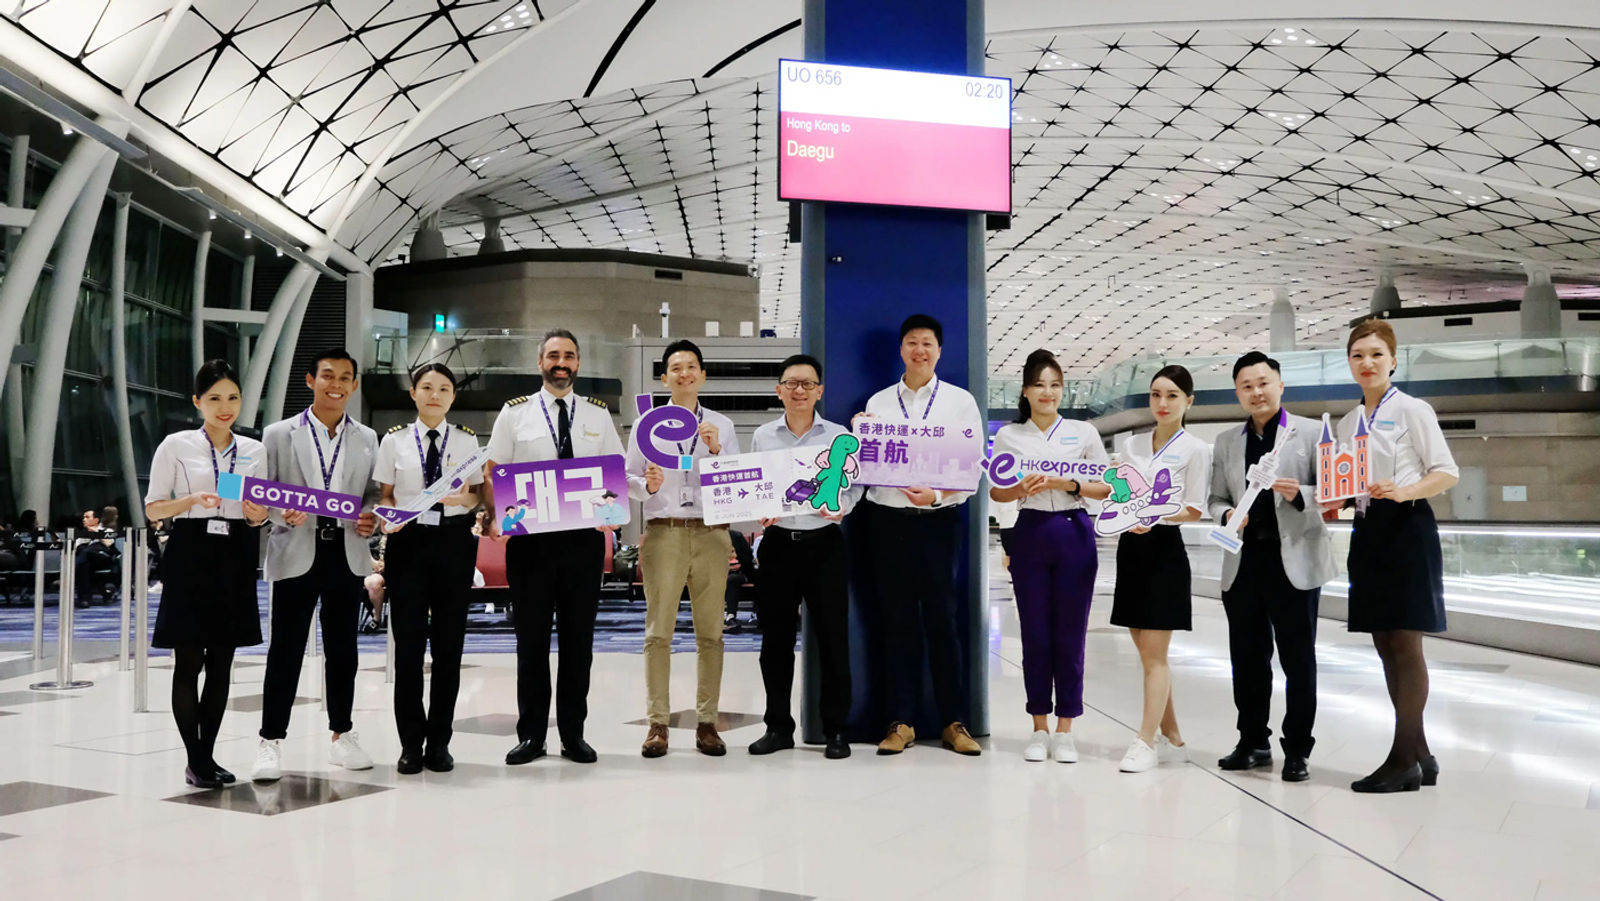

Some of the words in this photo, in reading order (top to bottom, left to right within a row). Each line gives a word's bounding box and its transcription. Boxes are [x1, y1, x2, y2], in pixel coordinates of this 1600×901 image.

[787, 67, 811, 83] UO
[815, 69, 842, 86] 656
[965, 81, 1003, 99] 02:20
[786, 117, 812, 133] Hong
[814, 119, 839, 134] Kong
[841, 122, 851, 133] to
[787, 140, 835, 163] Daegu
[860, 437, 909, 464] 首航
[712, 470, 759, 483] 香港快運首航
[1020, 459, 1107, 476] HKexpress
[514, 466, 607, 523] 대구
[713, 486, 731, 497] 香港
[754, 481, 774, 492] 大邱
[250, 484, 319, 509] GOTTA
[326, 498, 355, 514] GO
[713, 497, 732, 505] HKG
[755, 492, 774, 500] TAE
